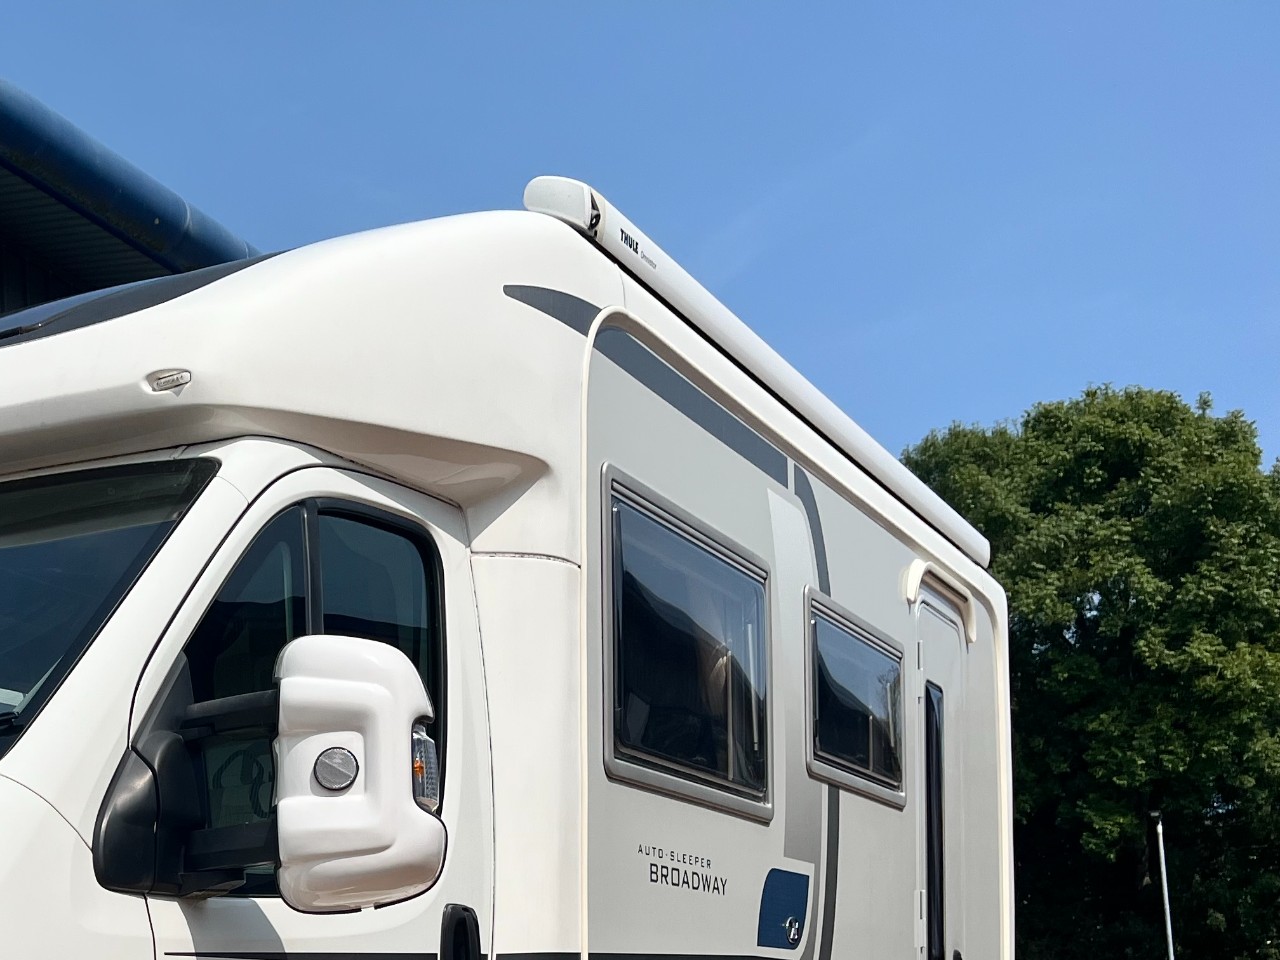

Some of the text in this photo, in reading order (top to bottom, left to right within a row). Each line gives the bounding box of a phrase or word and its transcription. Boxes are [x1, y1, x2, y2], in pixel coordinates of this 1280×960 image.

[620, 228, 639, 254] THULE
[638, 844, 711, 869] AUTO-SLEEPER
[650, 863, 727, 896] BROADWAY
